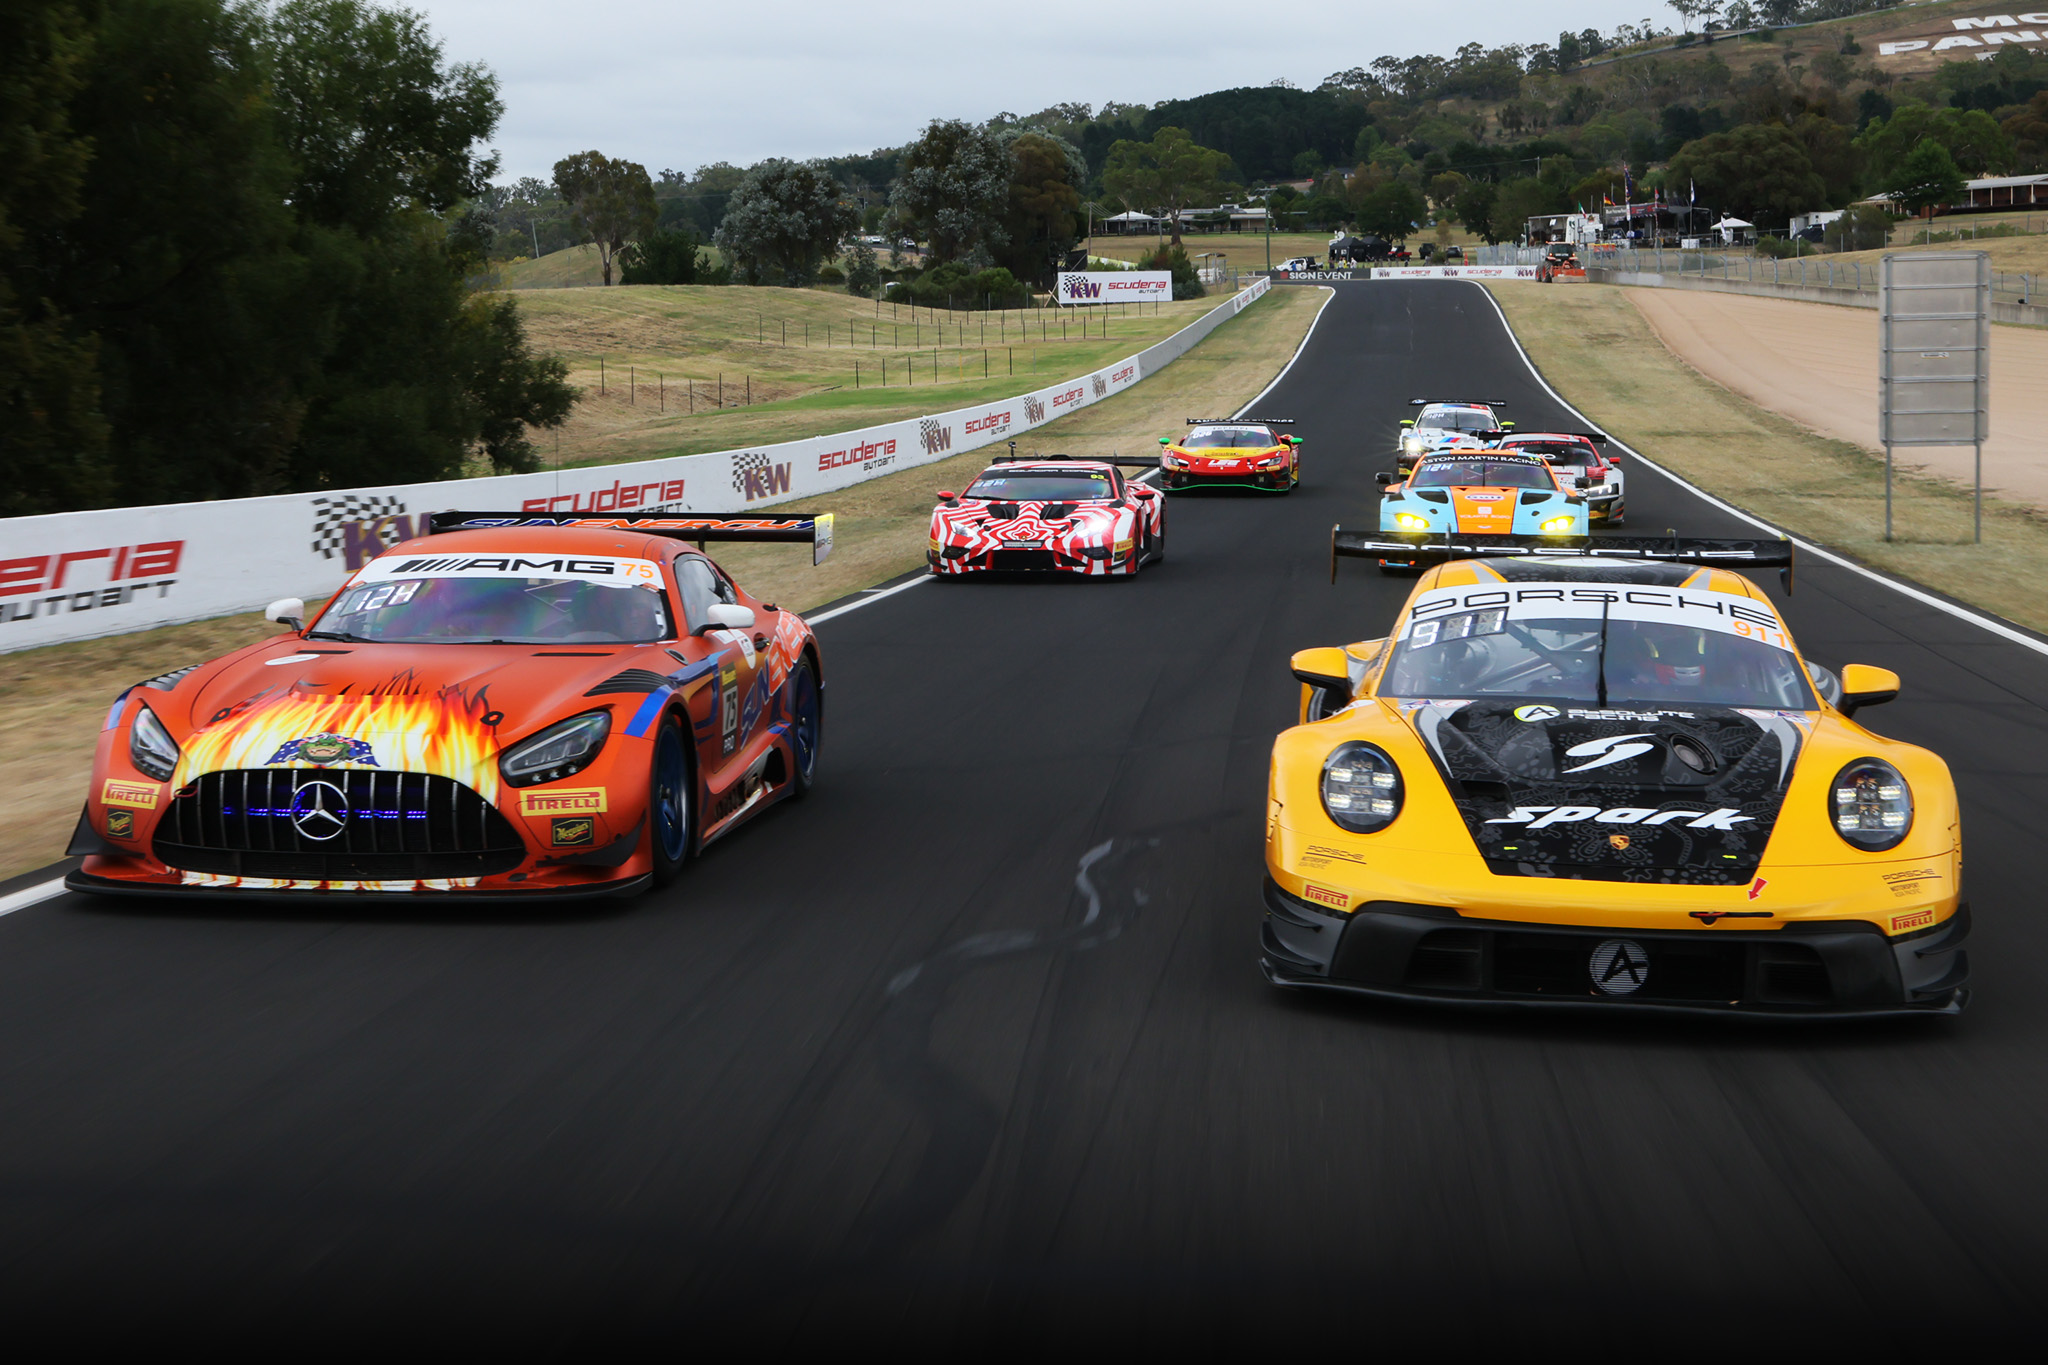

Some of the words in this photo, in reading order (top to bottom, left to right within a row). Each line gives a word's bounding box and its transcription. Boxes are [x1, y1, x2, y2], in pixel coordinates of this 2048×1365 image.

[1070, 282, 1101, 298] KW
[1108, 280, 1167, 290] scuderia
[1053, 387, 1083, 407] scuderia
[965, 411, 1011, 434] scuderia
[1028, 401, 1045, 425] KW
[926, 426, 952, 455] KW
[818, 438, 897, 472] scuderia
[863, 455, 896, 471] autoart
[1421, 456, 1456, 465] ASTON
[1500, 456, 1541, 466] RACING
[744, 462, 792, 502] KW
[620, 563, 655, 579] 75
[356, 582, 421, 612] 12H
[1412, 589, 1777, 631] PORSCHE
[1410, 610, 1505, 649] 911
[1732, 620, 1787, 648] 911
[105, 782, 156, 805] PIRELLI
[526, 791, 601, 811] PIRELLI
[1307, 845, 1365, 861] PORSCHE
[1881, 868, 1936, 881] PORSCHE
[1305, 884, 1349, 908] PIRELLI
[1891, 910, 1933, 931] PIRELLI
